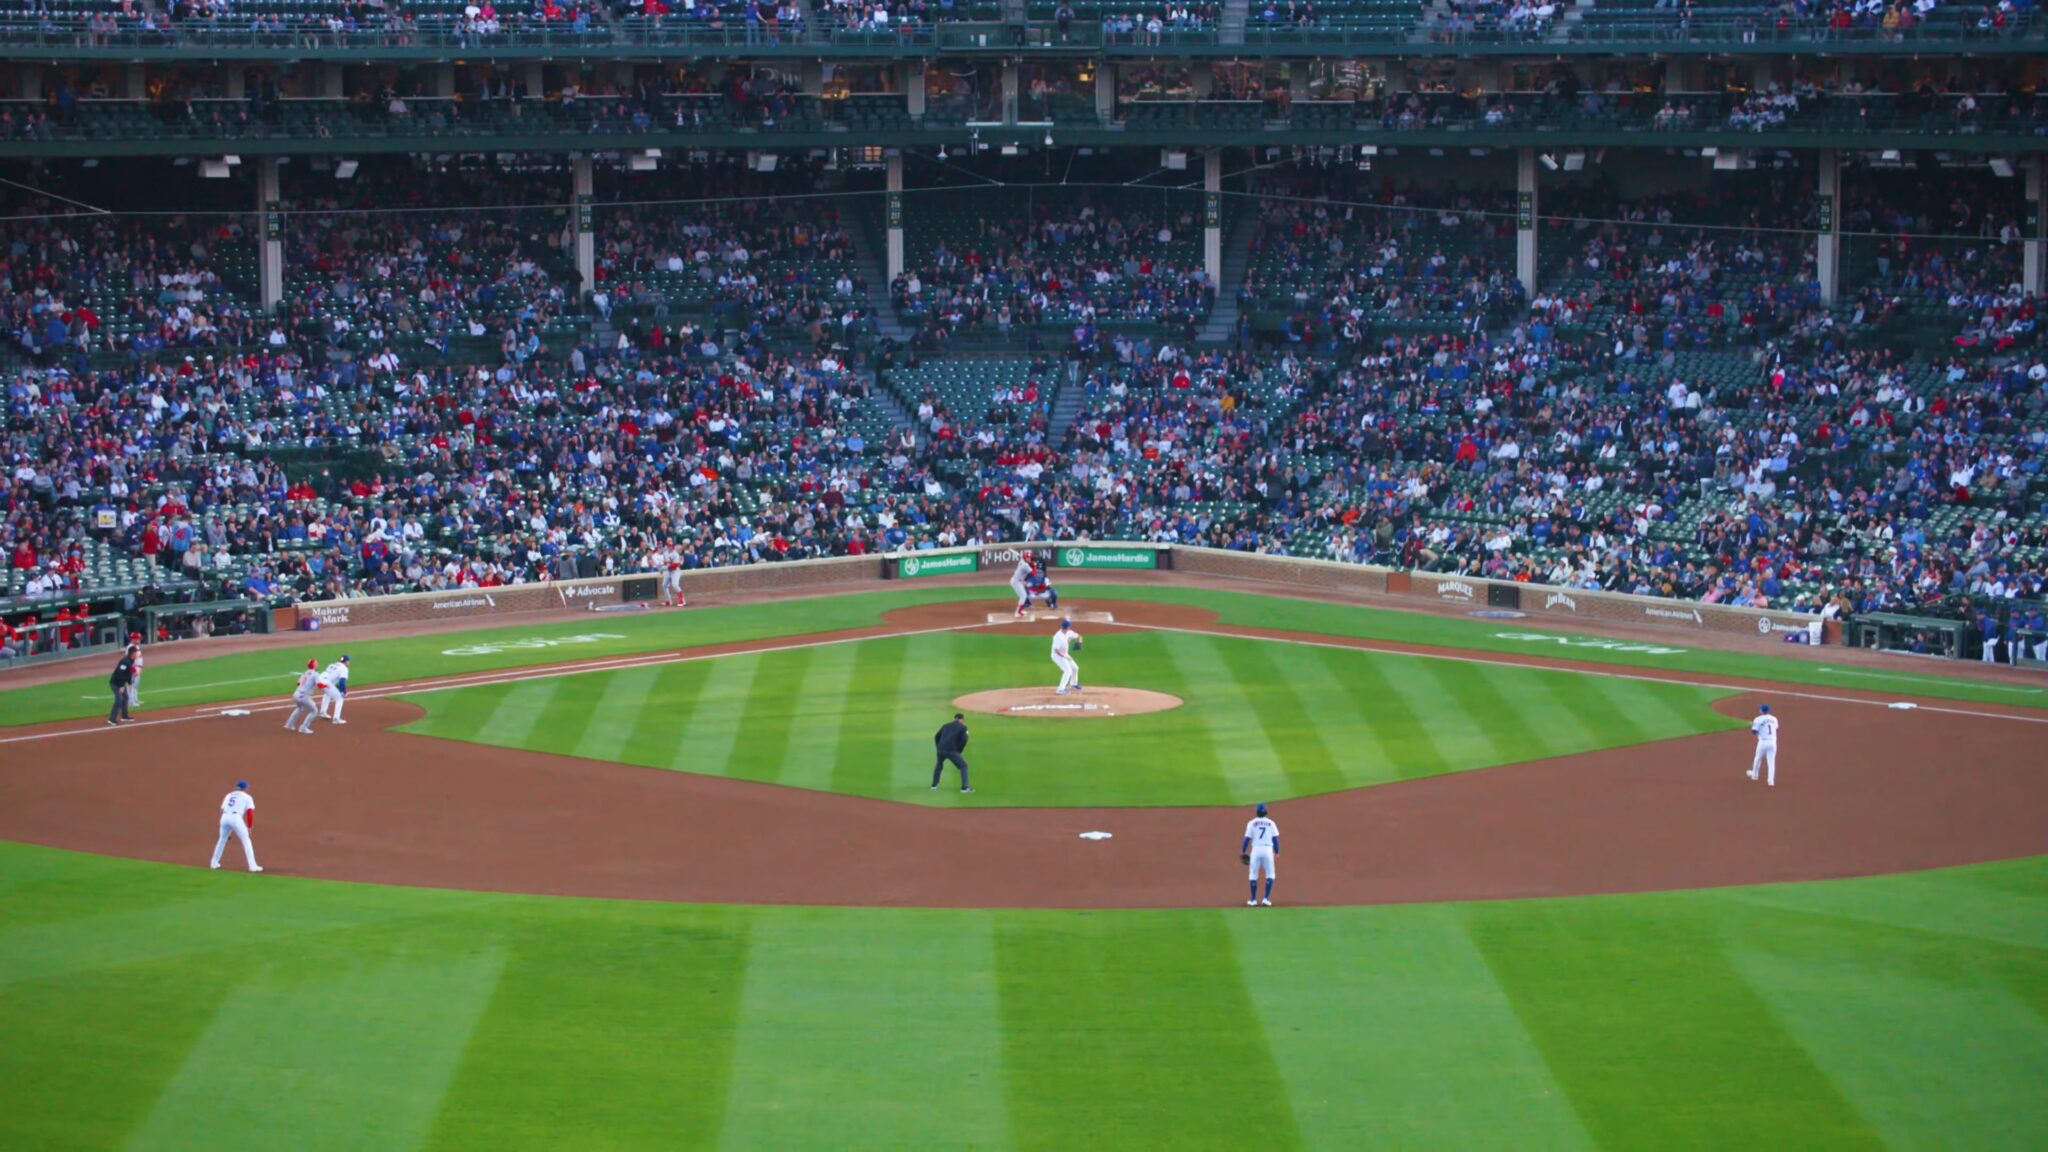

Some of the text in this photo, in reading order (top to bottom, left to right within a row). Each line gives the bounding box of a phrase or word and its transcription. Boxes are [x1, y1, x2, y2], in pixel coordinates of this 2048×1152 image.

[994, 549, 1052, 563] HORIN
[1086, 553, 1149, 563] JamesHardie
[921, 556, 972, 569] JamesHardie
[577, 585, 615, 597] Advocate
[1438, 581, 1473, 597] MARQUEE
[433, 600, 462, 609] American
[312, 606, 350, 616] Maker's
[1645, 607, 1671, 617] American
[322, 615, 349, 624] Mark
[1767, 724, 1772, 735] 1
[228, 796, 236, 807] 5
[1258, 827, 1266, 839] 7
